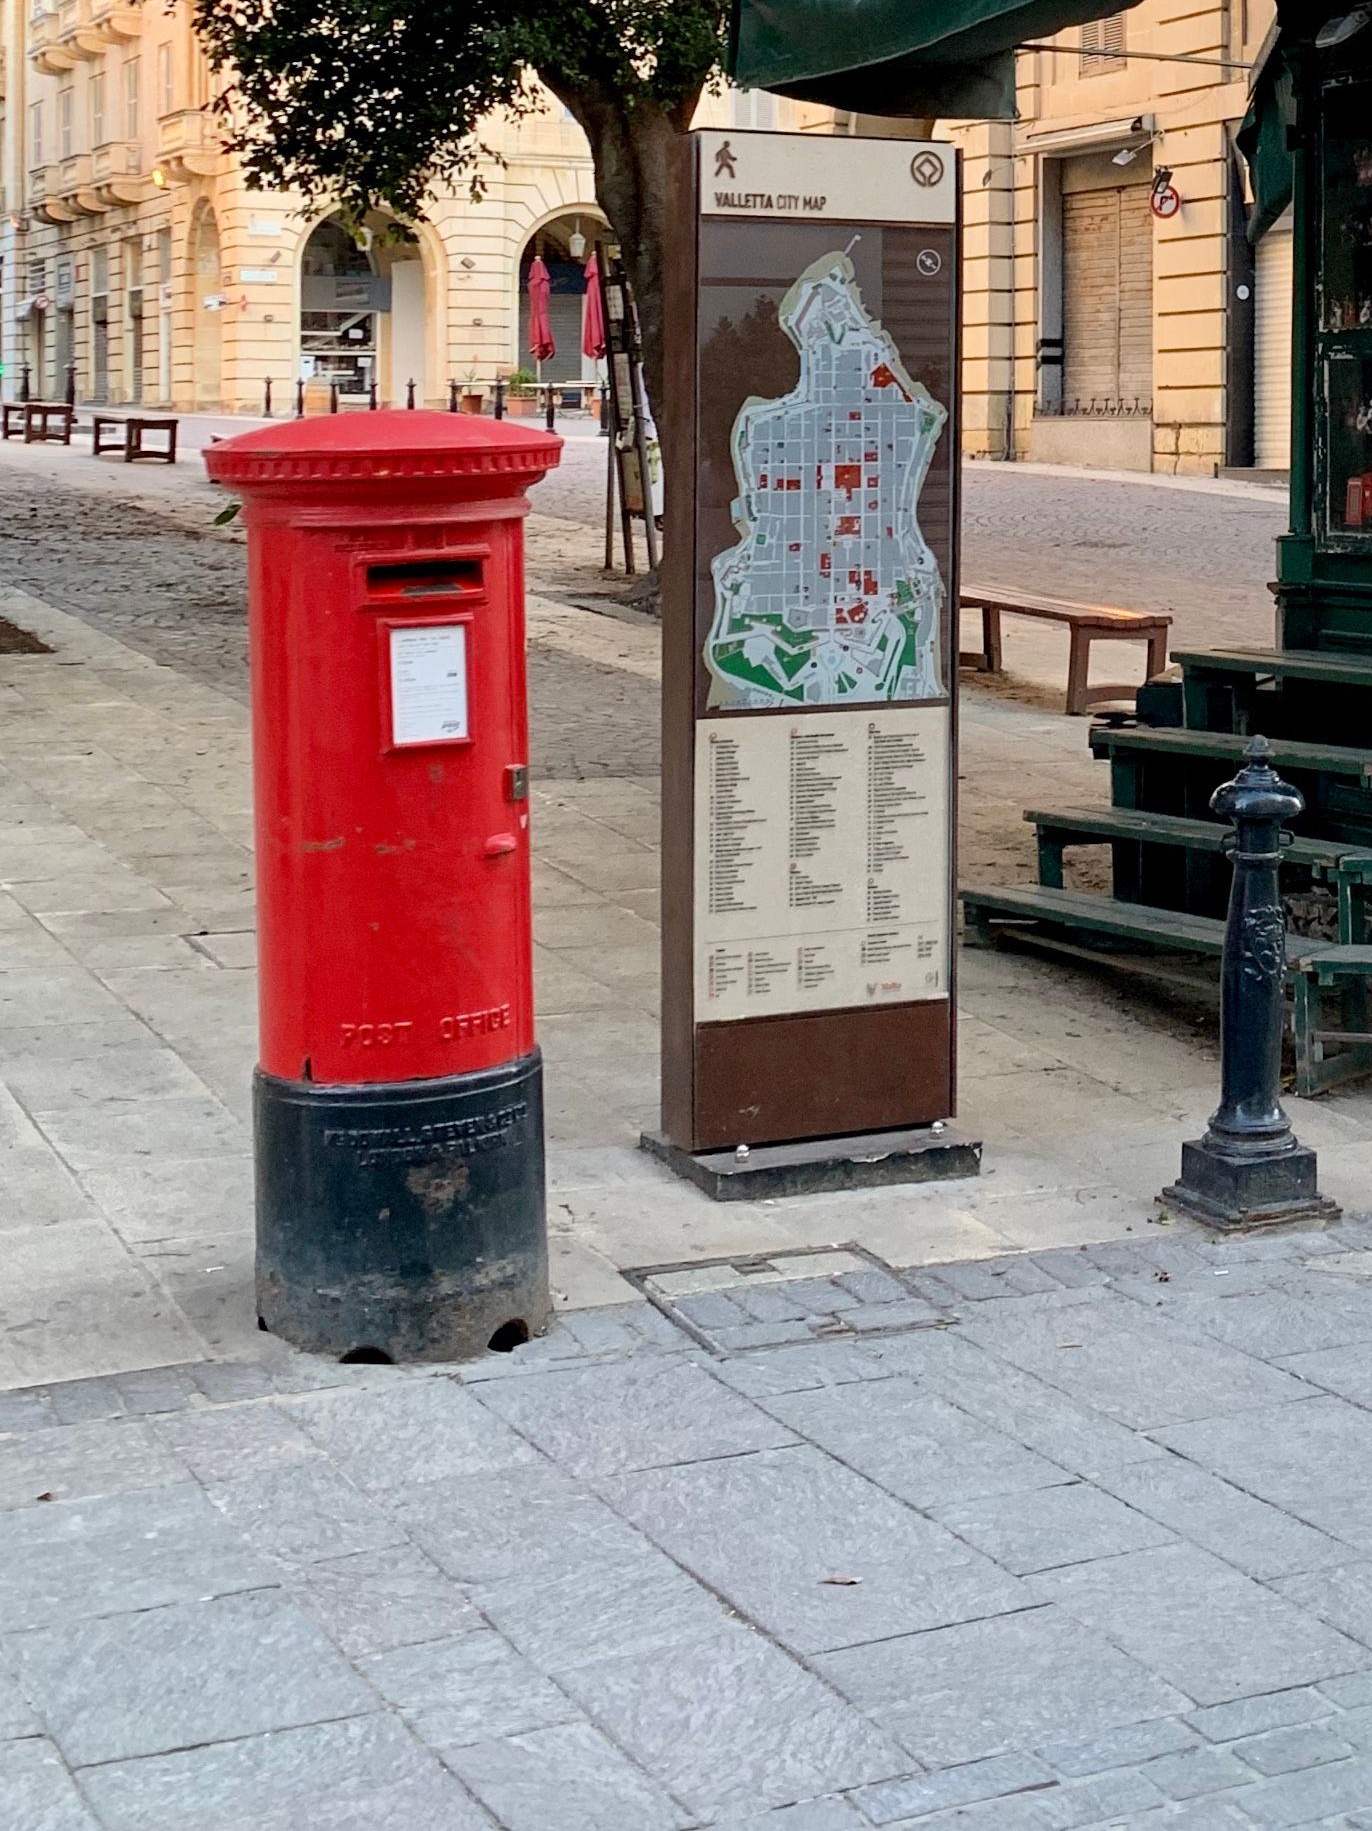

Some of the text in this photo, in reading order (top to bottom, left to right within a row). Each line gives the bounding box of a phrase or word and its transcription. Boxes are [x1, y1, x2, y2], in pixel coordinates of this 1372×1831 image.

[714, 192, 827, 211] VALLETTA CITY MAP
[340, 1003, 511, 1048] POST OFFICE
